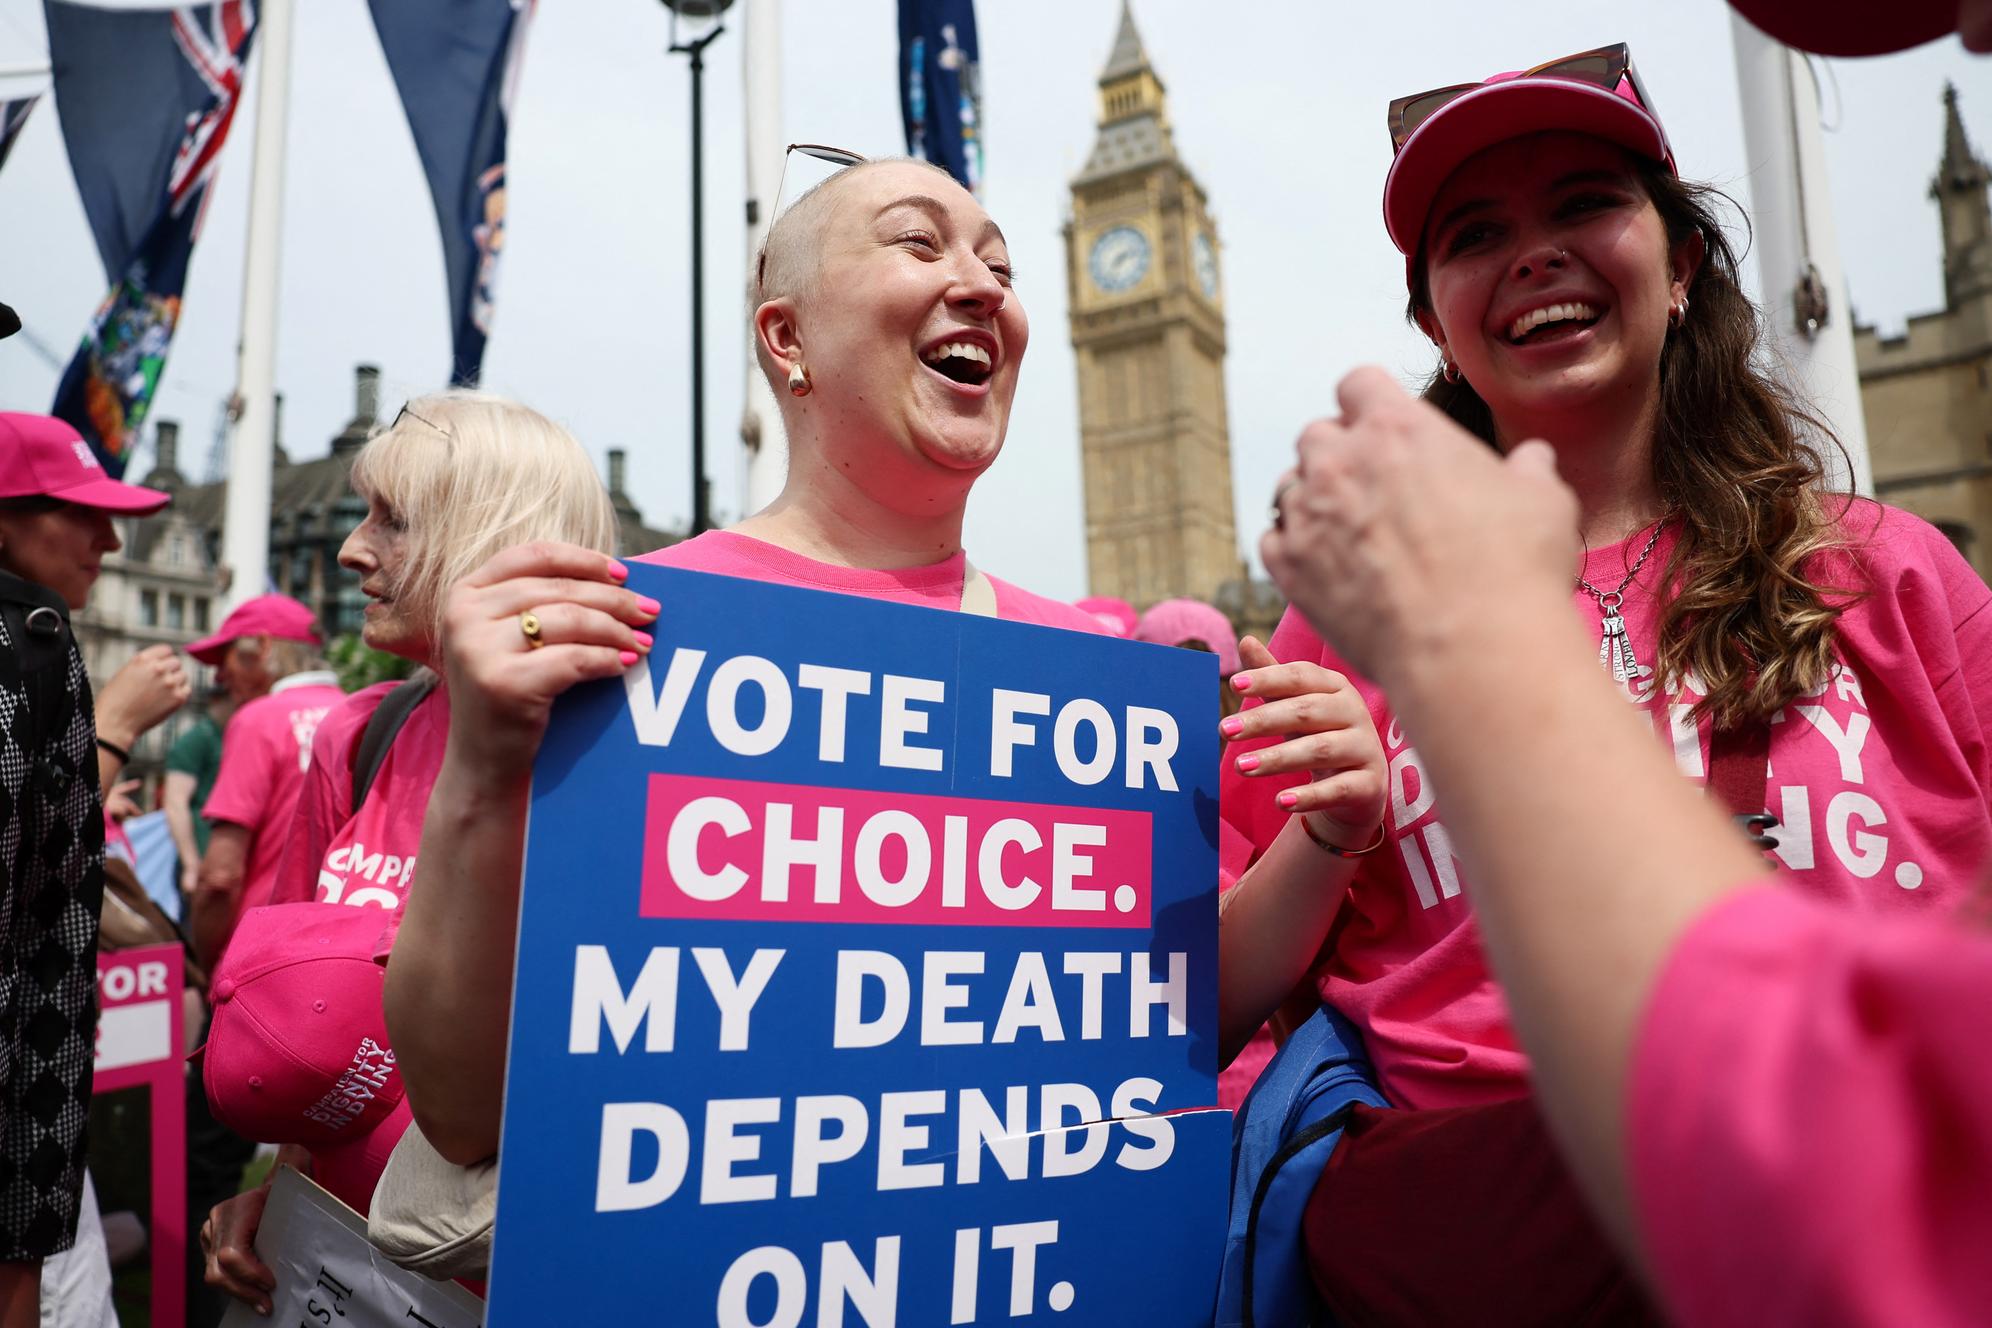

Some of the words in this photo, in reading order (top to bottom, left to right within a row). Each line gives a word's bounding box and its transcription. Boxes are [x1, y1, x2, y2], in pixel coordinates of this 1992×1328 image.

[1612, 642, 1625, 680] STRONG
[1621, 640, 1639, 676] LOVED
[623, 648, 945, 772] VOTE
[990, 688, 1180, 792] FOR
[666, 796, 1137, 913] CHOICE.
[97, 961, 168, 1001] OR
[569, 944, 787, 1056] MY
[833, 950, 1188, 1049] DEATH
[303, 1067, 357, 1117] CAMPAIGN
[353, 1037, 374, 1065] FOR
[312, 1041, 385, 1122] DIGNITY
[326, 1114, 352, 1130] IN
[346, 1048, 397, 1116] DYING
[595, 1077, 1176, 1212] DEPENDS
[717, 1235, 901, 1328] ON
[951, 1220, 1075, 1325] IT.
